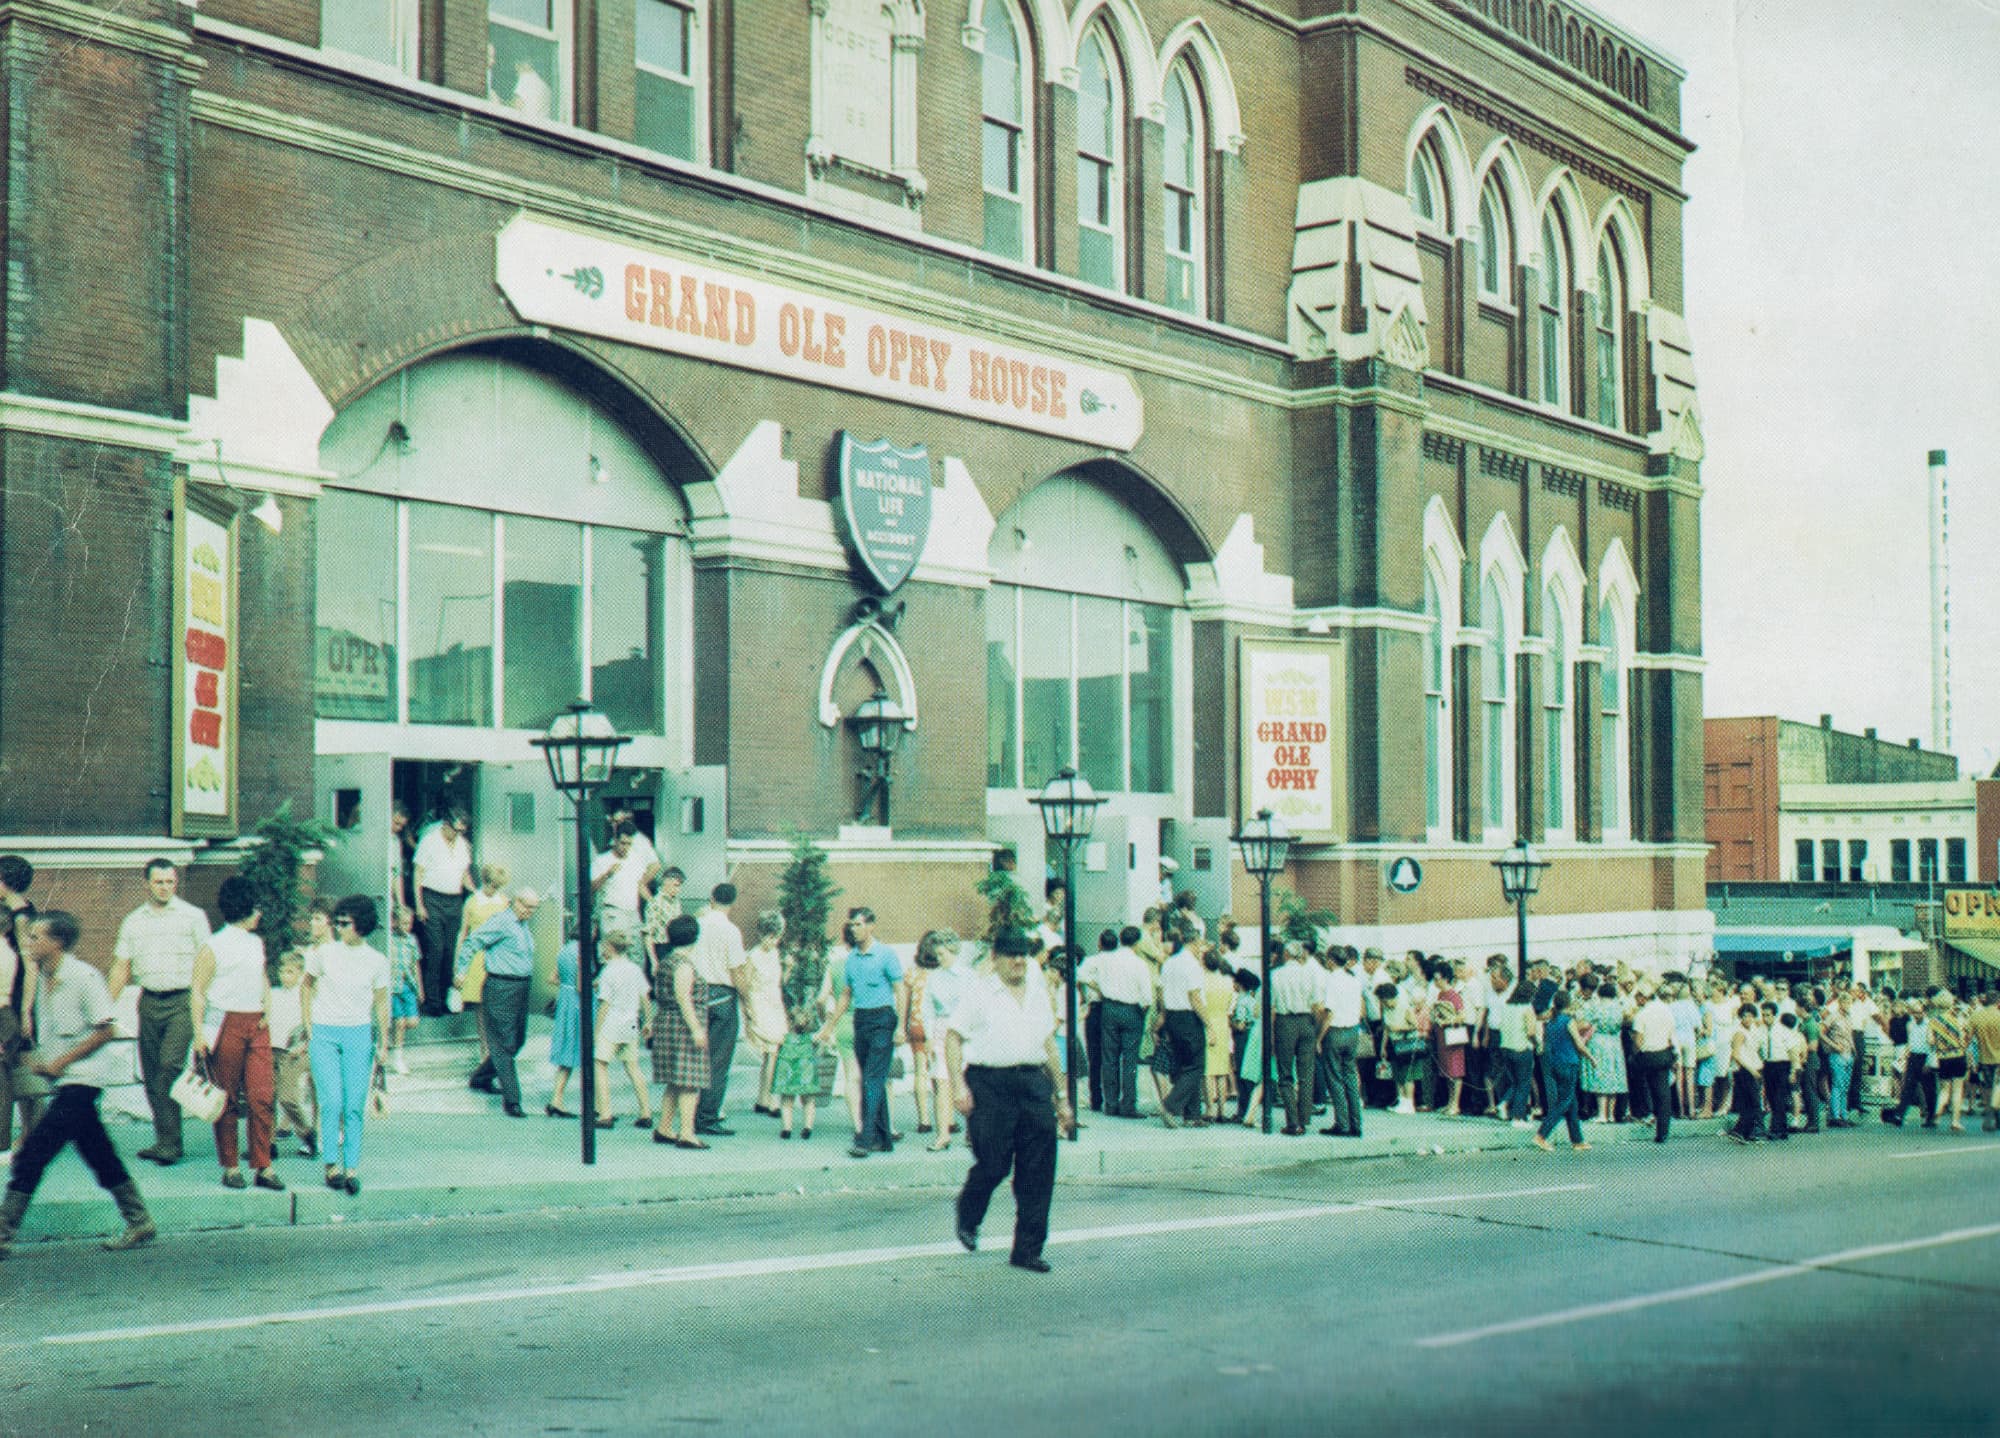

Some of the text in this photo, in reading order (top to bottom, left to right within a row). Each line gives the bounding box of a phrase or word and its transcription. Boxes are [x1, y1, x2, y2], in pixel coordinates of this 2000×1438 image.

[624, 263, 1068, 420] GRAND OLE OPRY HOUSE
[855, 468, 924, 498] NATIONAL
[877, 495, 905, 516] LIFE
[1257, 721, 1327, 743] GRAND
[1274, 745, 1311, 767] OLE
[1266, 768, 1319, 791] OPRY
